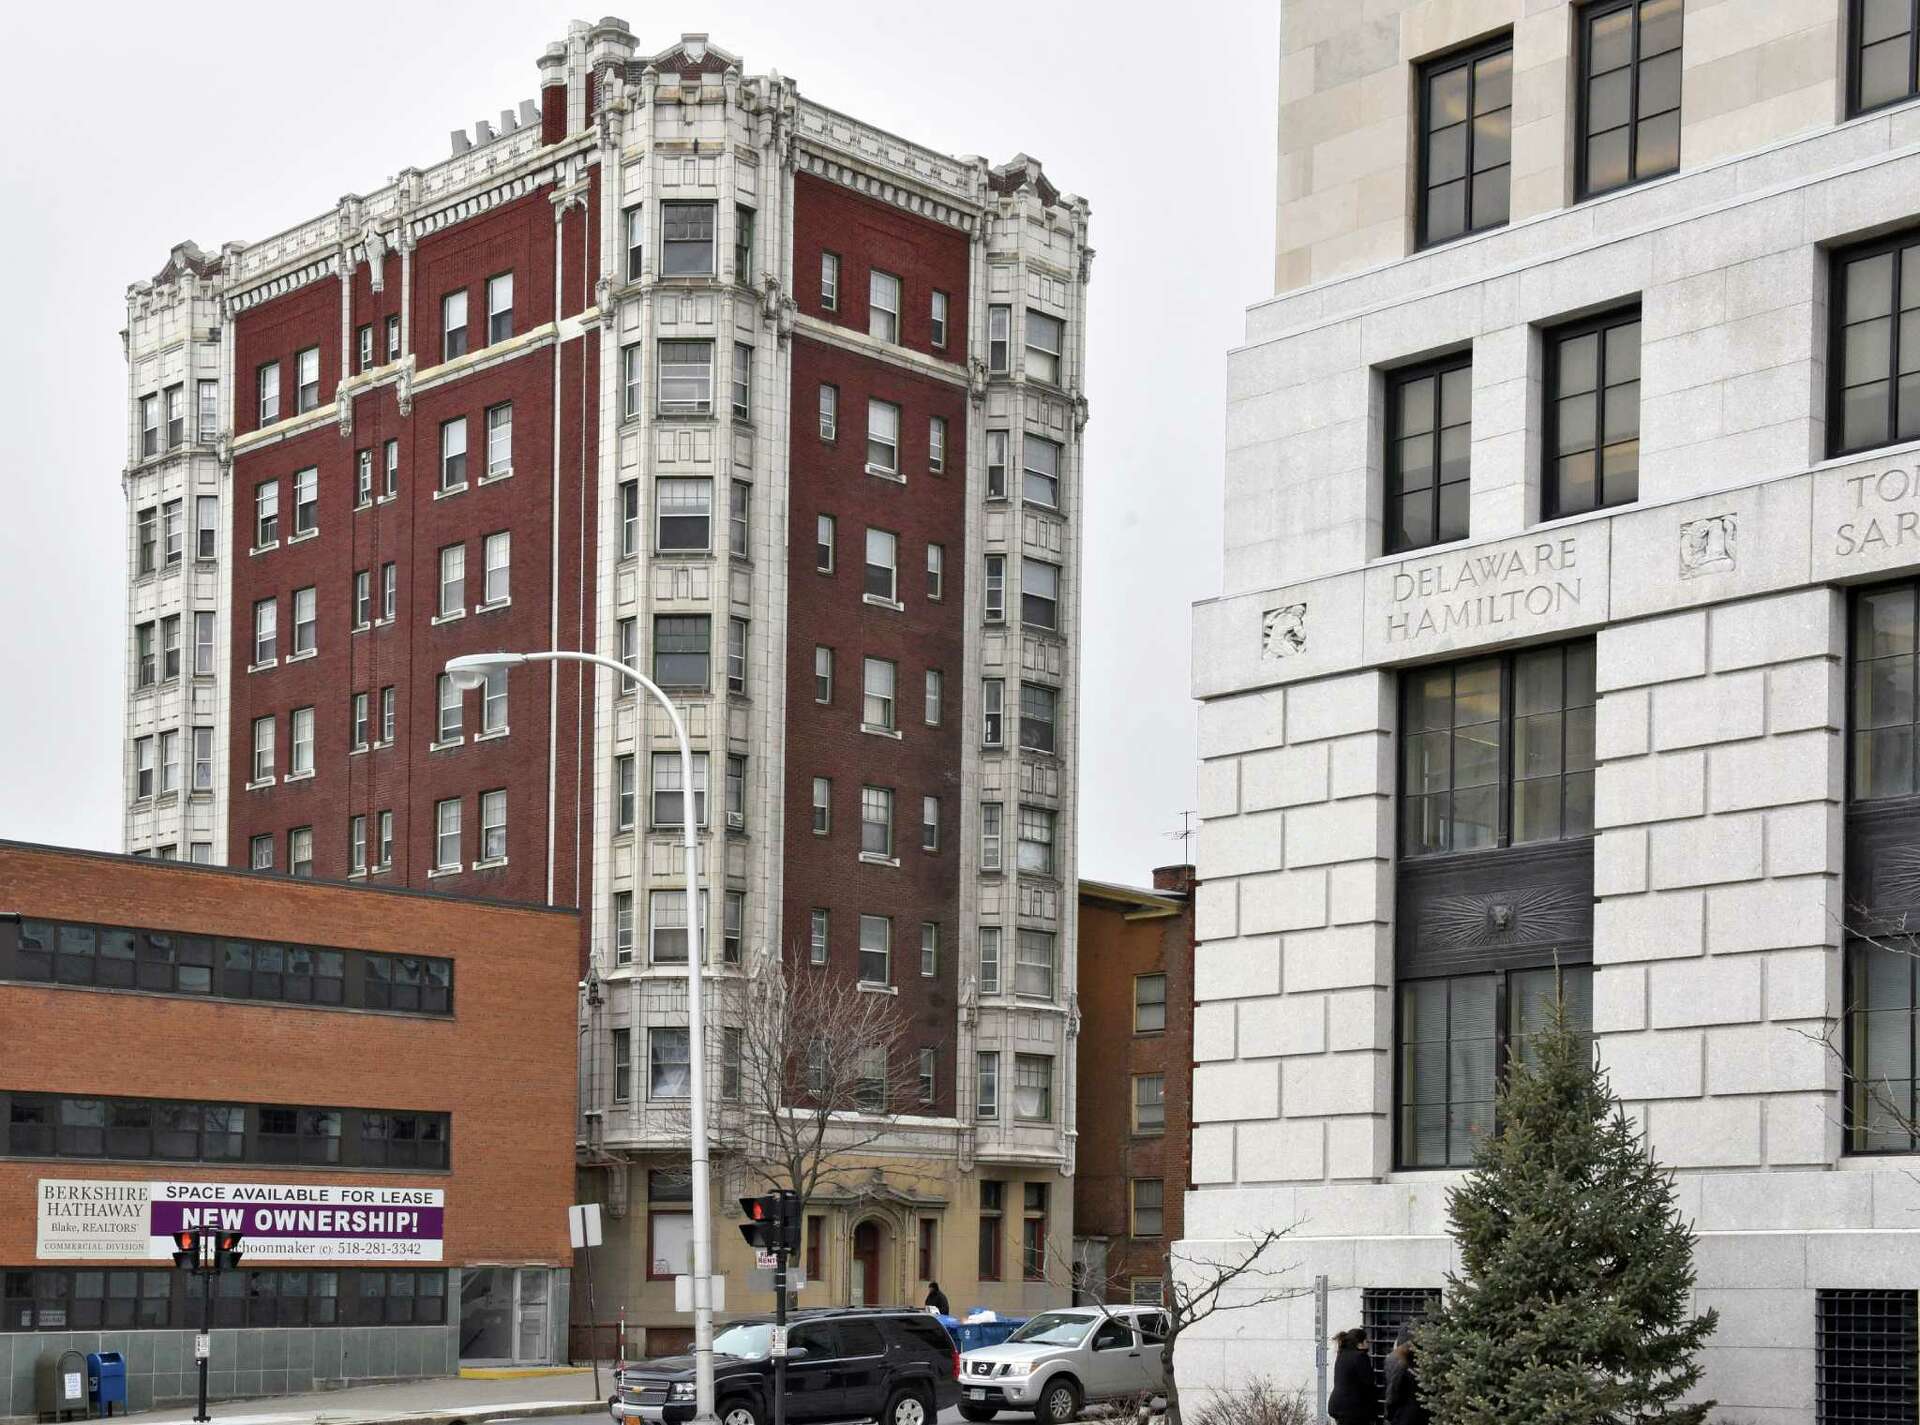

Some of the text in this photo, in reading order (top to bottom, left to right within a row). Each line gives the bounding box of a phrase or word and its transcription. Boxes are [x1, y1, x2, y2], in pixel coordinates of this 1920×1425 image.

[1392, 537, 1577, 603] DELAWARE
[1386, 577, 1582, 644] HAMILTON
[44, 1185, 148, 1201] BERKSHIRE
[166, 1185, 433, 1205] SPACE AVAILABLE FOR LEASE
[47, 1202, 144, 1217] HATHAWAY
[51, 1222, 80, 1234] Blake,
[182, 1207, 418, 1233] NEW OWNERSHIP!
[44, 1242, 145, 1252] COMMERCIAL DIVISION
[236, 1240, 316, 1255] choonmaker
[338, 1241, 421, 1256] 518-281-3342
